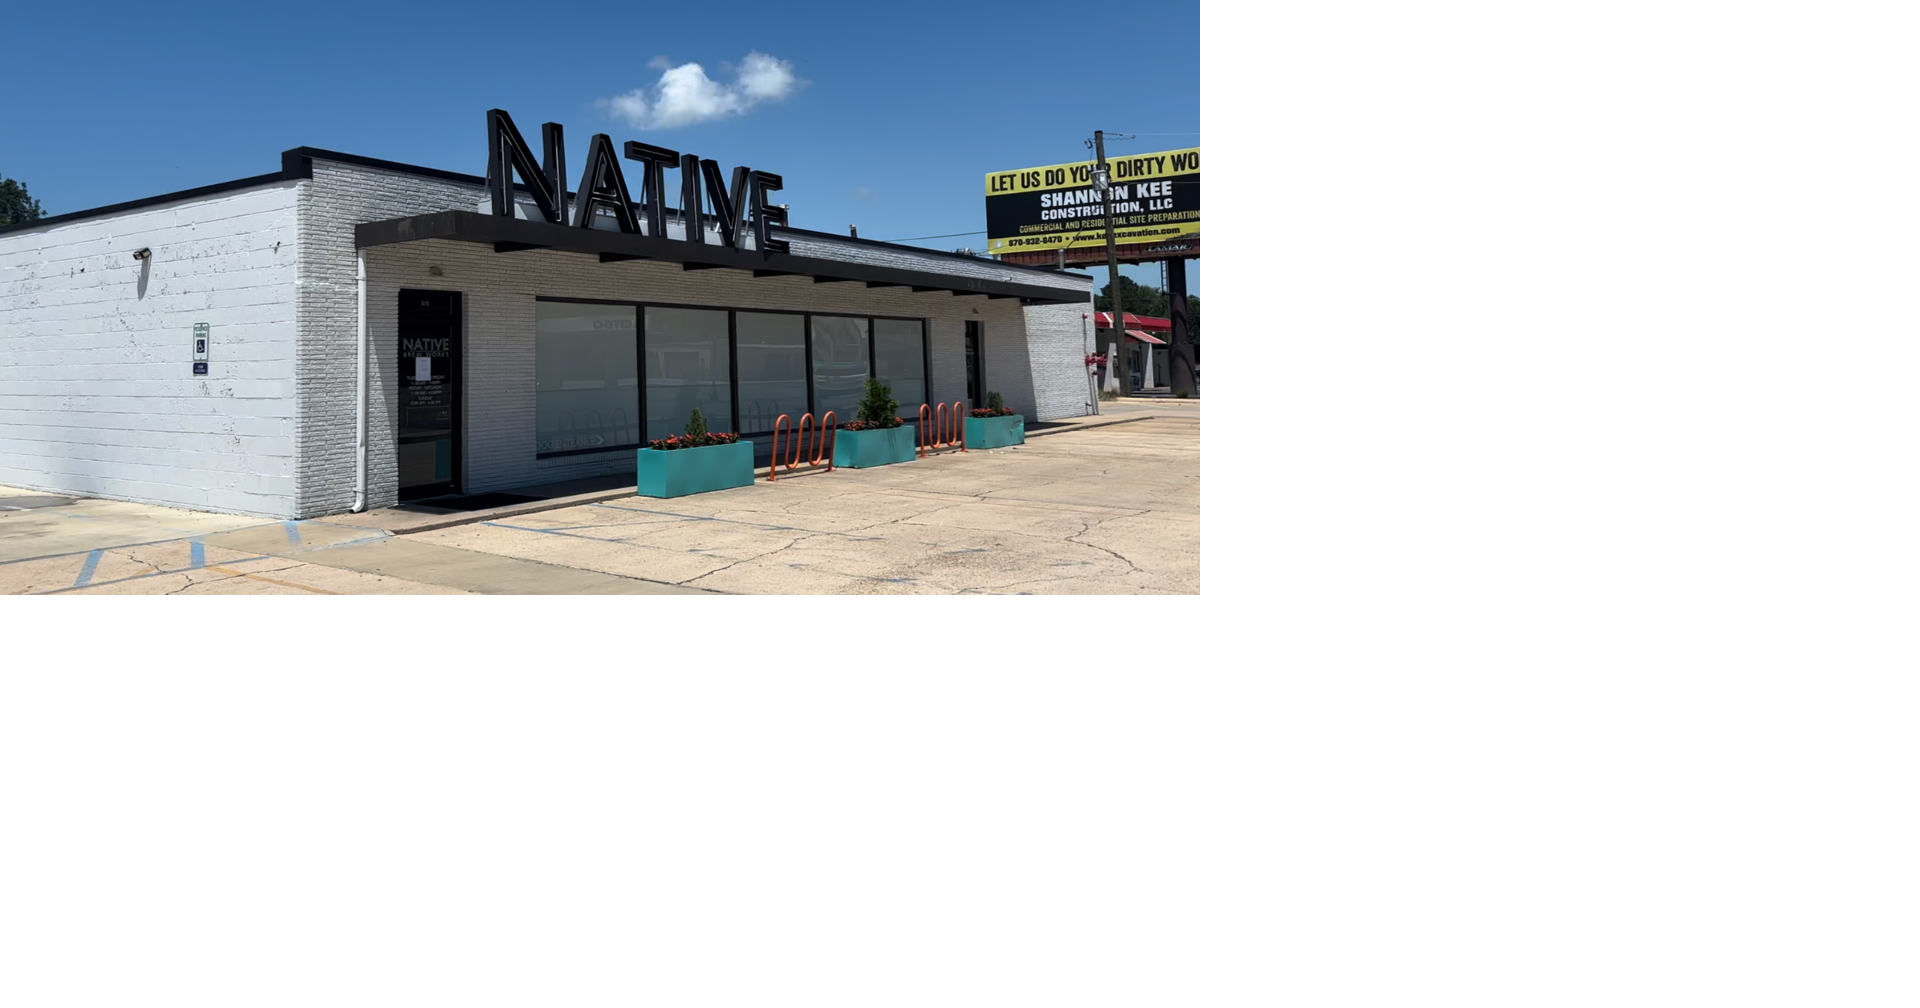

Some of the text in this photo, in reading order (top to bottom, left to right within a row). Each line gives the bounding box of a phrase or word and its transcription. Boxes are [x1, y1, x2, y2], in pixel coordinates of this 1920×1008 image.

[487, 108, 790, 254] NATIVE
[991, 174, 1017, 192] LET
[1021, 171, 1041, 189] US
[1045, 168, 1066, 186] DO
[1117, 155, 1166, 178] DIRTY
[1136, 180, 1172, 199] KEE
[1149, 198, 1173, 211] LLC
[1019, 222, 1064, 234] COMMERCIAL
[1065, 220, 1080, 230] AND
[1081, 216, 1128, 228] RESIDETIAL
[1129, 214, 1146, 224] SITE
[402, 337, 450, 351] NATIVE
[555, 437, 597, 448] ENTRANCE
